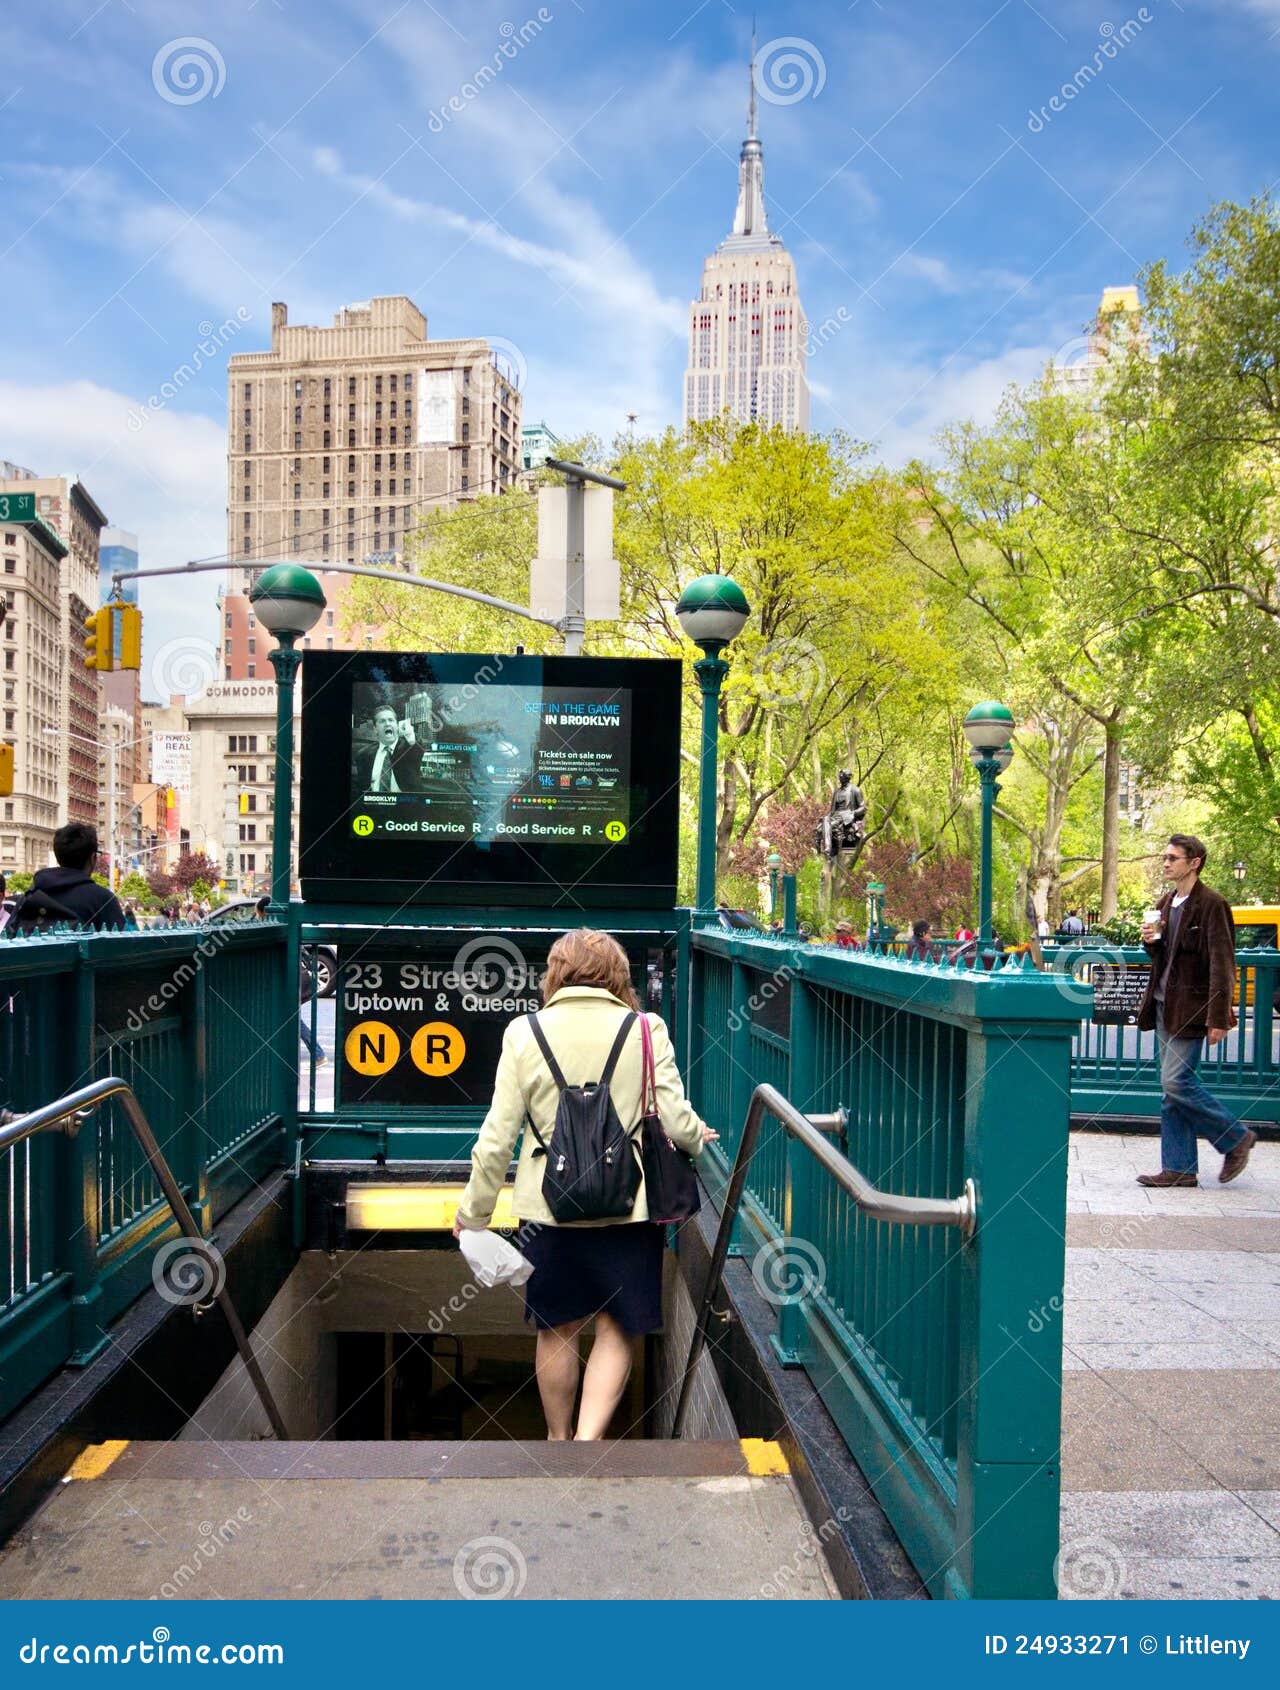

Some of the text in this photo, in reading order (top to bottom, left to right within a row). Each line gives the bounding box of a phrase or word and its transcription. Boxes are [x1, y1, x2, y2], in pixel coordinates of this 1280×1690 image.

[18, 496, 30, 509] ST
[206, 686, 280, 698] COMMODOR
[524, 703, 621, 715] GET IN THE GAME
[545, 715, 620, 727] IN BROOKLYN
[539, 750, 566, 759] Tickets
[579, 751, 595, 760] sale
[385, 820, 418, 832] Good
[421, 822, 466, 834] Service
[472, 822, 482, 833] R
[496, 823, 529, 835] Good
[531, 824, 576, 836] Service
[582, 825, 592, 836] R
[344, 963, 383, 989] 23
[399, 964, 490, 990] Street
[344, 992, 540, 1015] Uptown & Queens
[359, 1033, 452, 1065] N R
